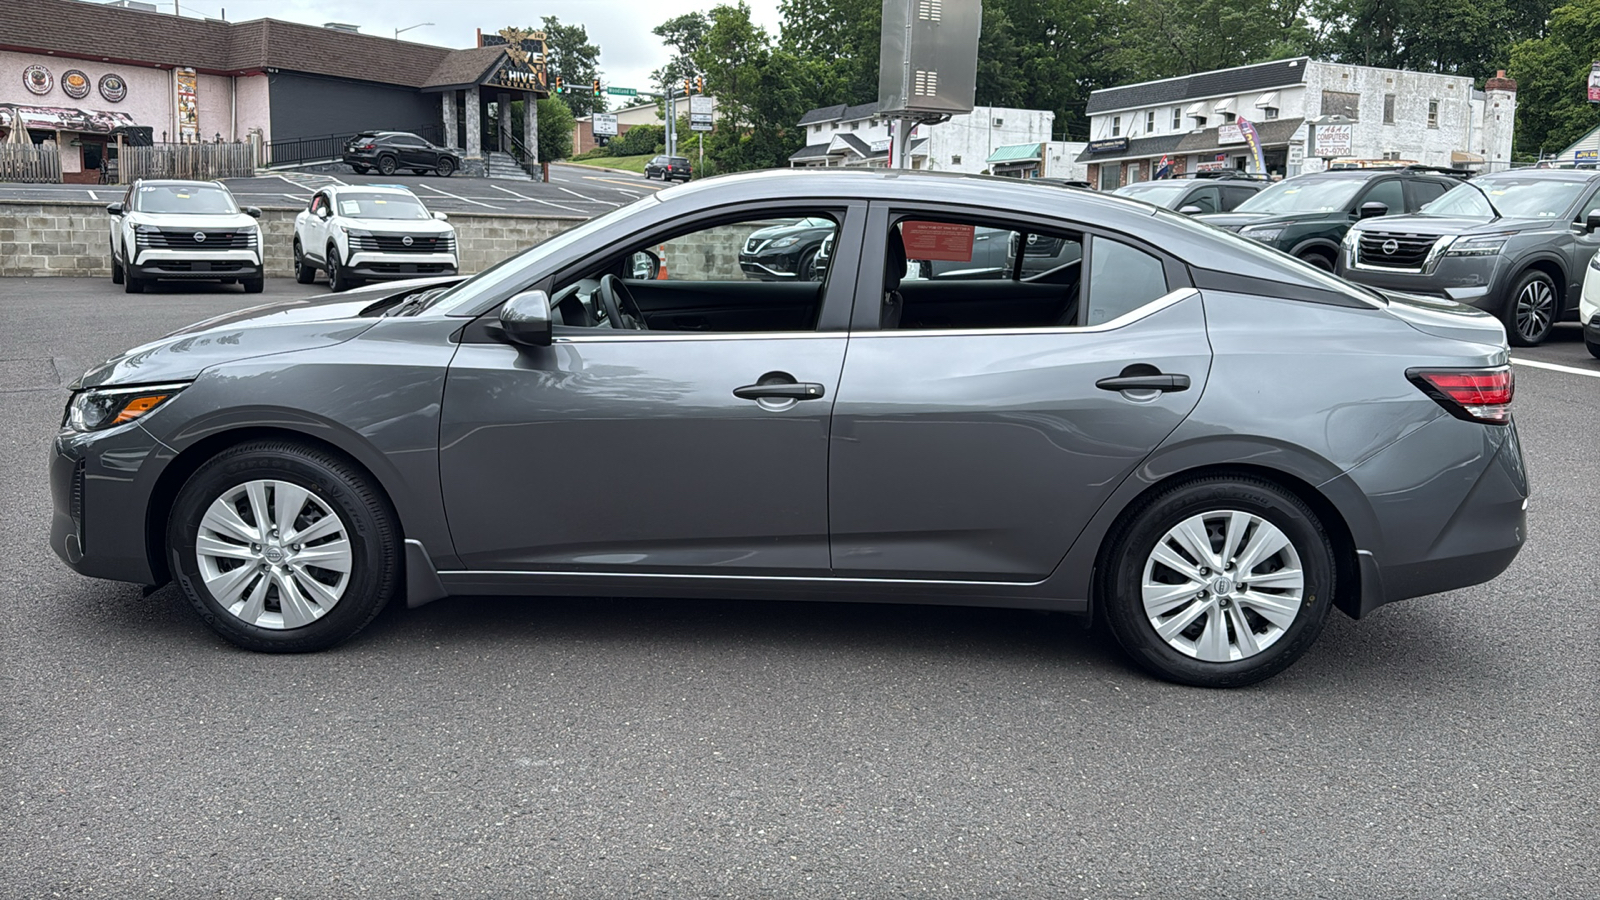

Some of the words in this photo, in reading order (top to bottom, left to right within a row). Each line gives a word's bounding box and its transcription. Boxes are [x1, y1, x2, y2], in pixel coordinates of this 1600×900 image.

[508, 70, 536, 84] HIVE
[501, 80, 536, 90] LOUNGE
[1316, 133, 1350, 141] COMPUTERS
[1315, 147, 1350, 155] 942-9700
